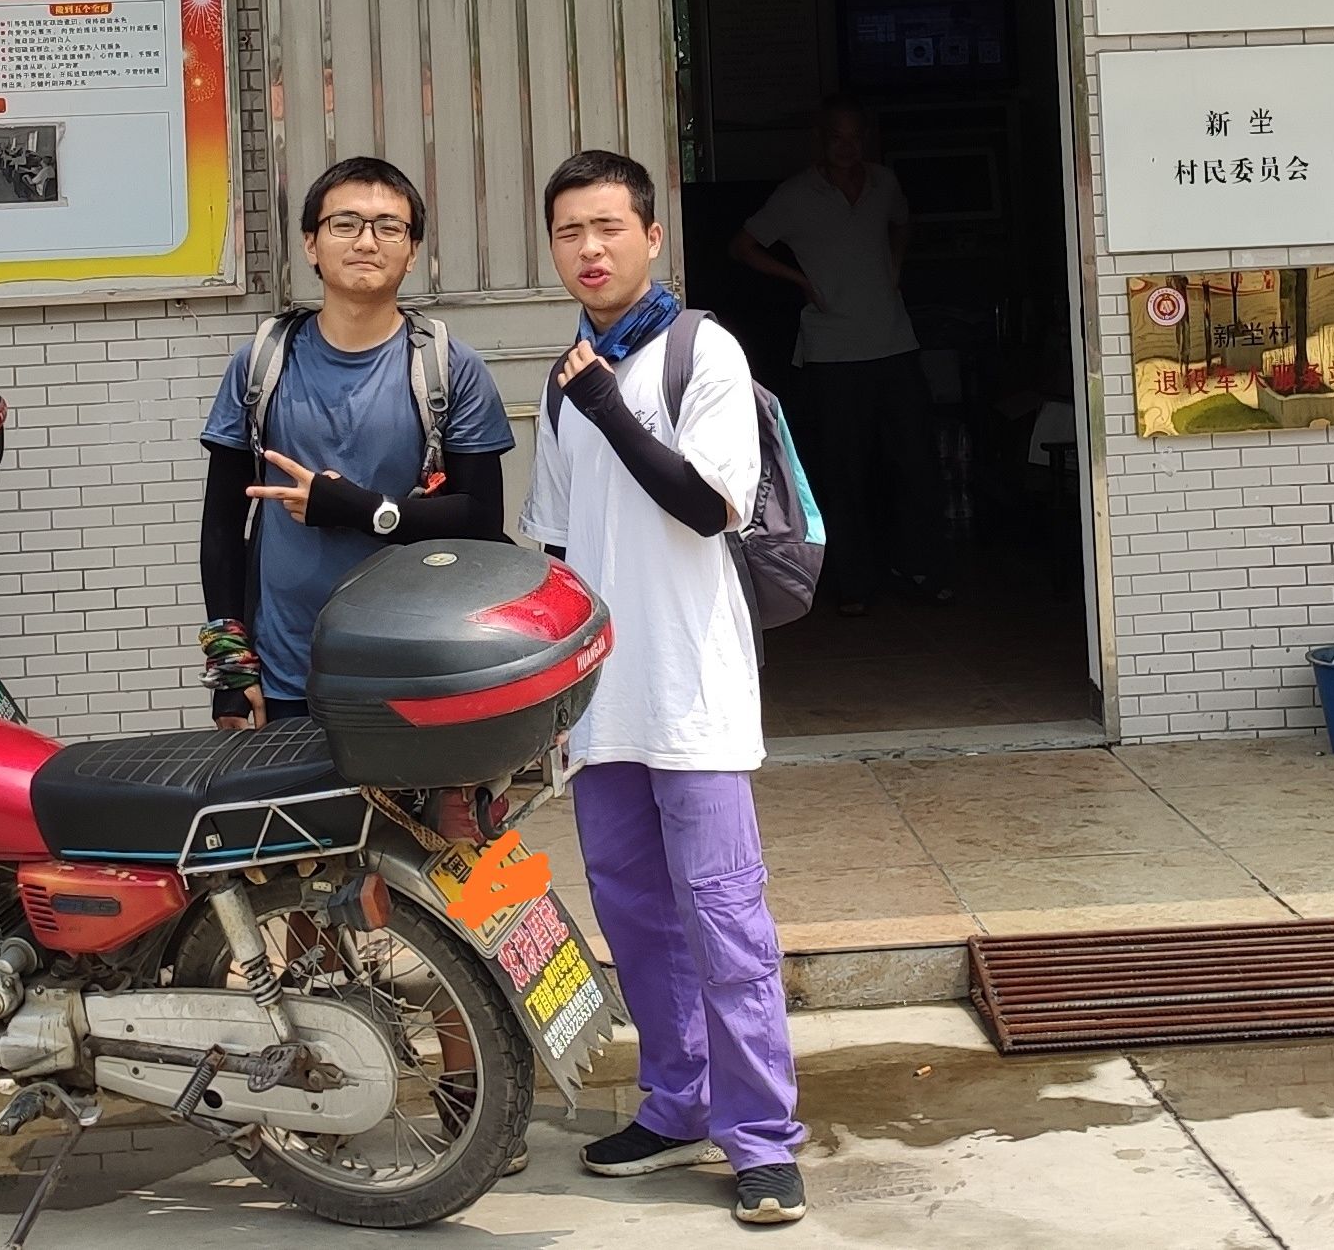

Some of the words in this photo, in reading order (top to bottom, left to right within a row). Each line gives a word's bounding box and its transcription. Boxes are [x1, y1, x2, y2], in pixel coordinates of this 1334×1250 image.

[1173, 155, 1310, 186] 村民委员会
